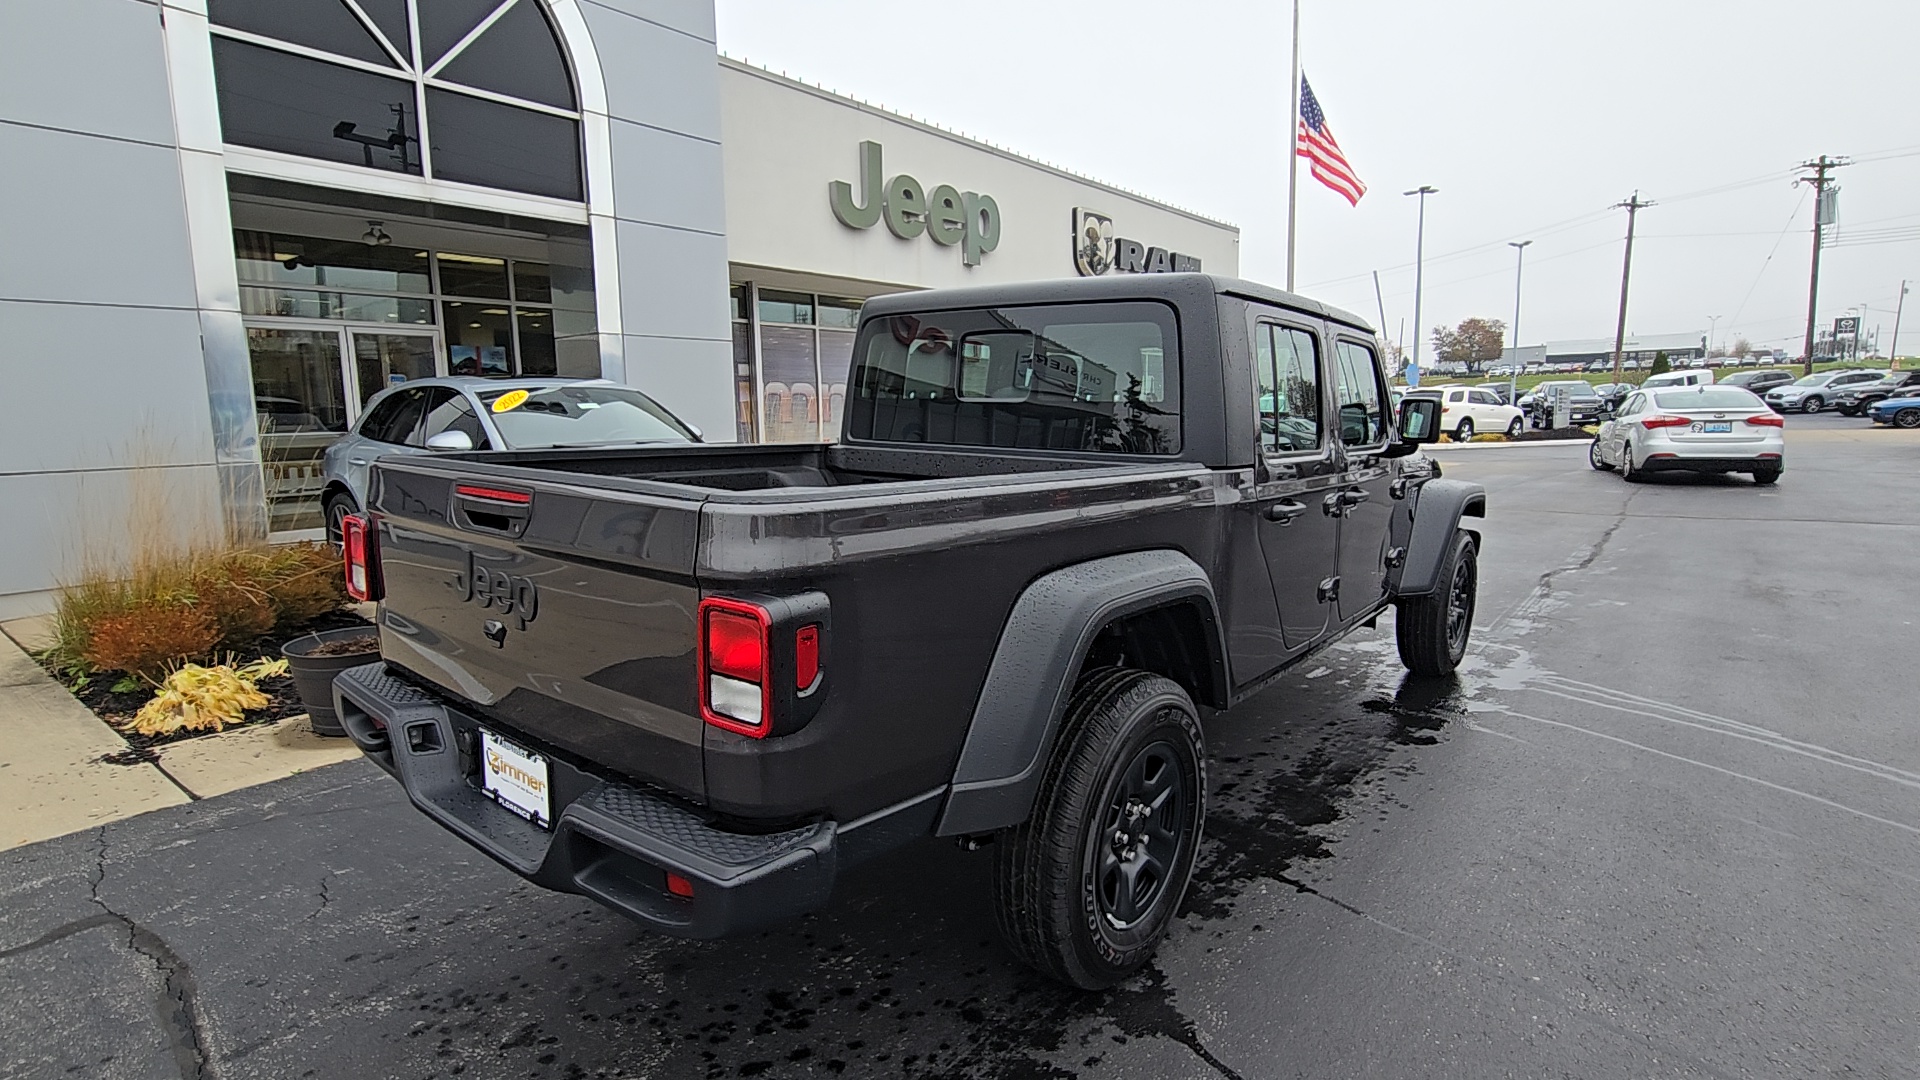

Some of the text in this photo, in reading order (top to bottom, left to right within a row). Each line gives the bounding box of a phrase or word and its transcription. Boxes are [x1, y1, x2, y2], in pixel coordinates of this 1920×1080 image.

[828, 139, 1001, 267] Jeep
[1114, 237, 1202, 273] RAM
[499, 392, 524, 410] 2022
[453, 549, 540, 632] Jeep
[488, 750, 547, 793] Zimmer
